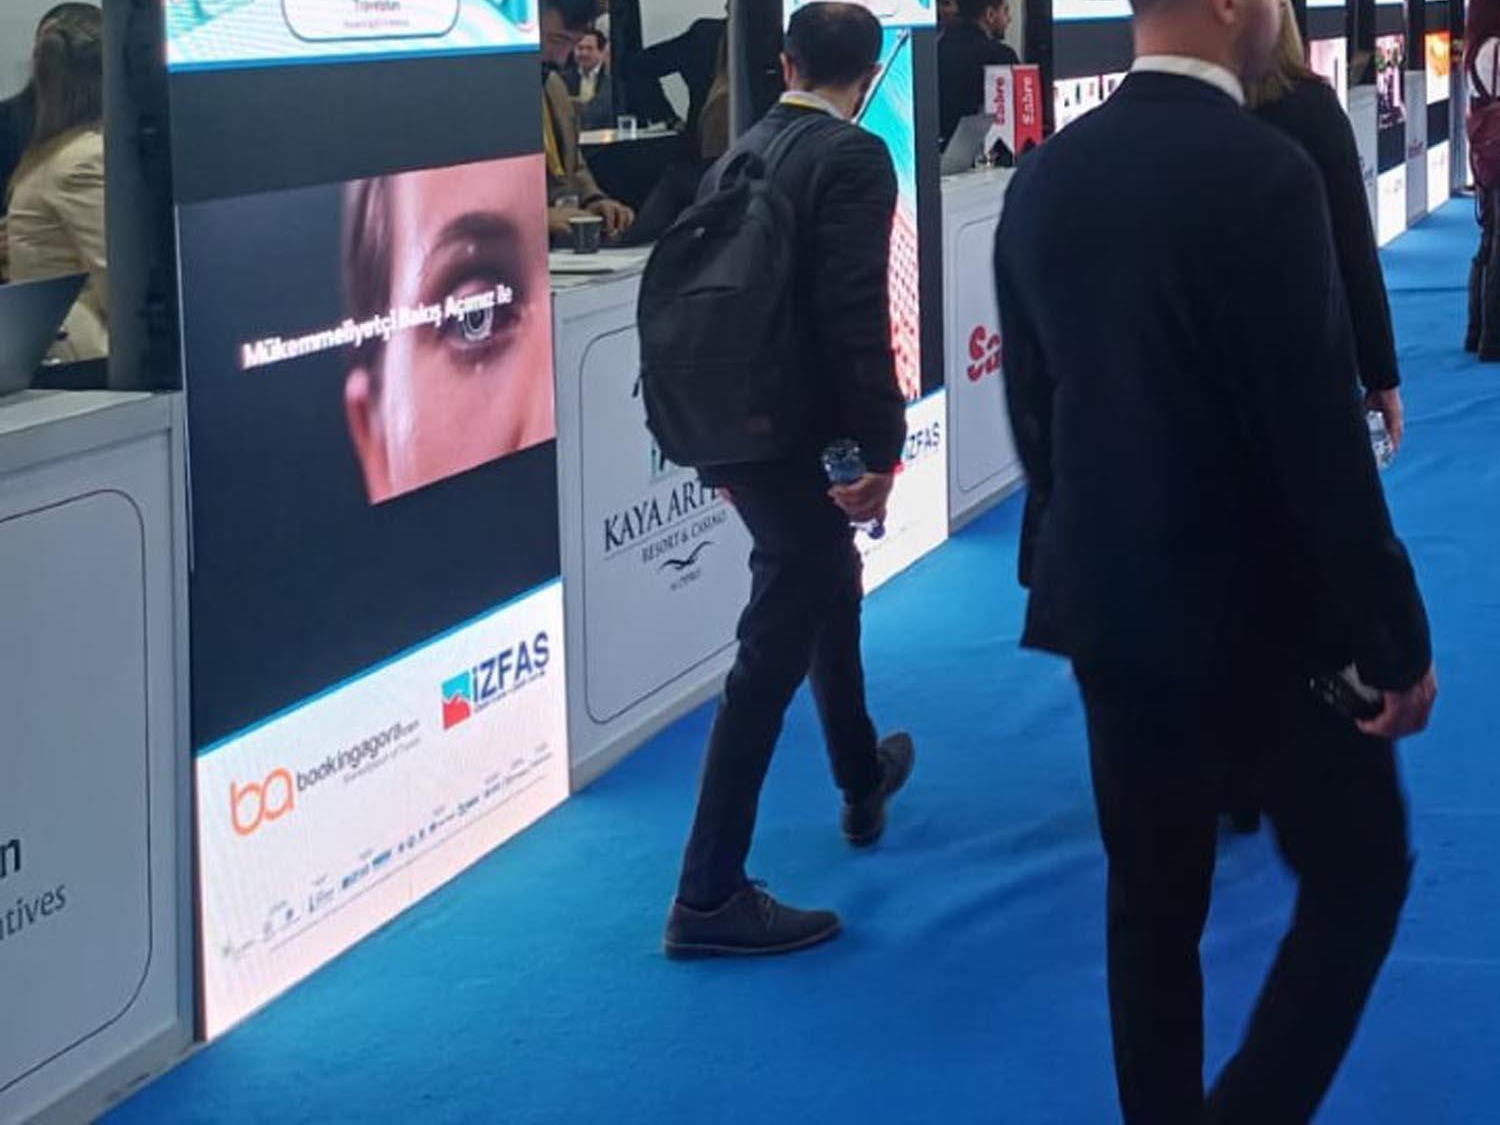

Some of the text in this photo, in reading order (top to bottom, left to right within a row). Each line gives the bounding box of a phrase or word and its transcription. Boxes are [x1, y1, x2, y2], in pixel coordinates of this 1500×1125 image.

[603, 494, 663, 553] KAYA
[641, 527, 681, 564] RESORT
[0, 883, 67, 941] tives
